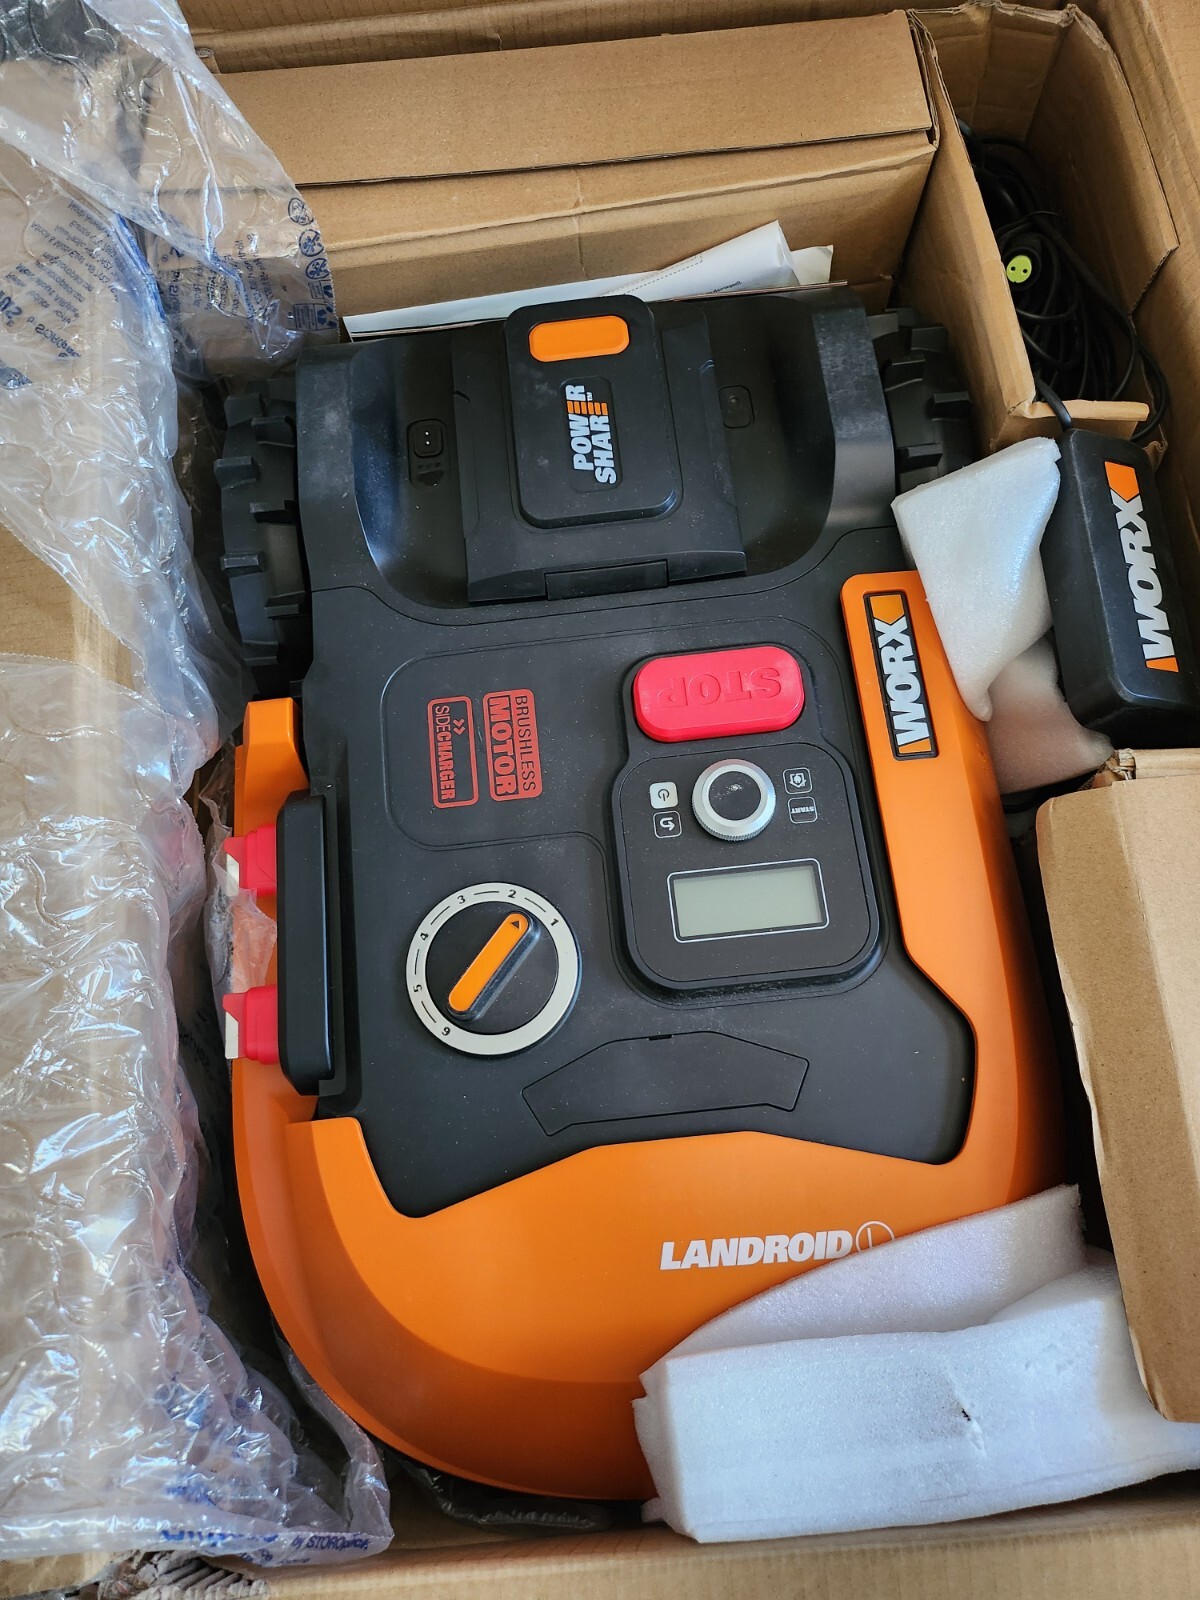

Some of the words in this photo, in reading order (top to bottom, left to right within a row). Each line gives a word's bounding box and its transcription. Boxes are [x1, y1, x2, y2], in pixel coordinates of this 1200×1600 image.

[565, 384, 594, 471] POWER
[589, 402, 617, 485] SHARE
[1109, 488, 1176, 659] WORX
[656, 666, 782, 709] STOP
[873, 614, 931, 745] WORX
[434, 705, 457, 800] SIDECHARGER
[488, 696, 518, 796] MOTOR
[515, 695, 537, 792] BRUSHLESS
[790, 805, 816, 815] START
[457, 895, 466, 905] 3
[508, 889, 518, 899] 2
[420, 932, 430, 941] 4
[550, 918, 560, 927] 1
[413, 984, 423, 993] 5
[441, 1026, 451, 1036] 6
[660, 1229, 853, 1270] LANDROID
